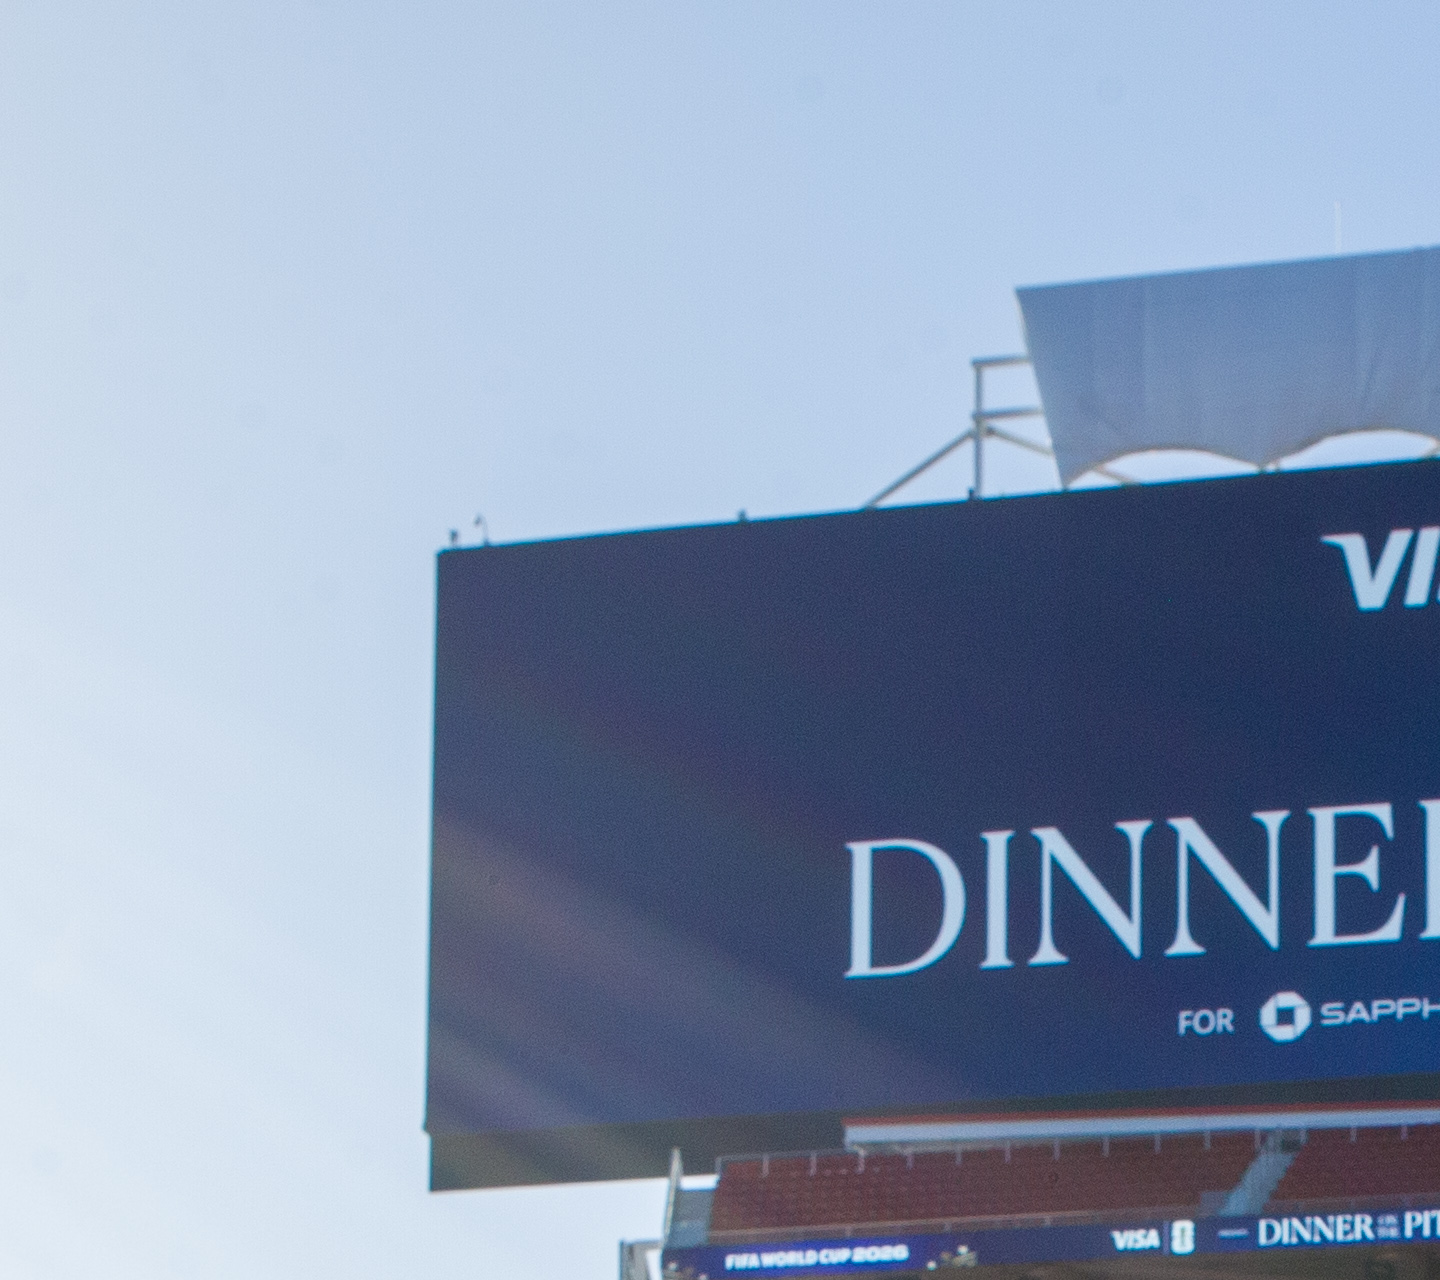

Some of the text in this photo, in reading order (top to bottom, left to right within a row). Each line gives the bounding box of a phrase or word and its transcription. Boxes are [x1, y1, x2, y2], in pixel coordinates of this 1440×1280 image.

[1177, 1008, 1234, 1037] FOR
[1110, 1228, 1160, 1251] VISA
[1258, 1213, 1376, 1247] DINNER
[760, 1249, 818, 1268] WORLD
[819, 1247, 852, 1265] CUP
